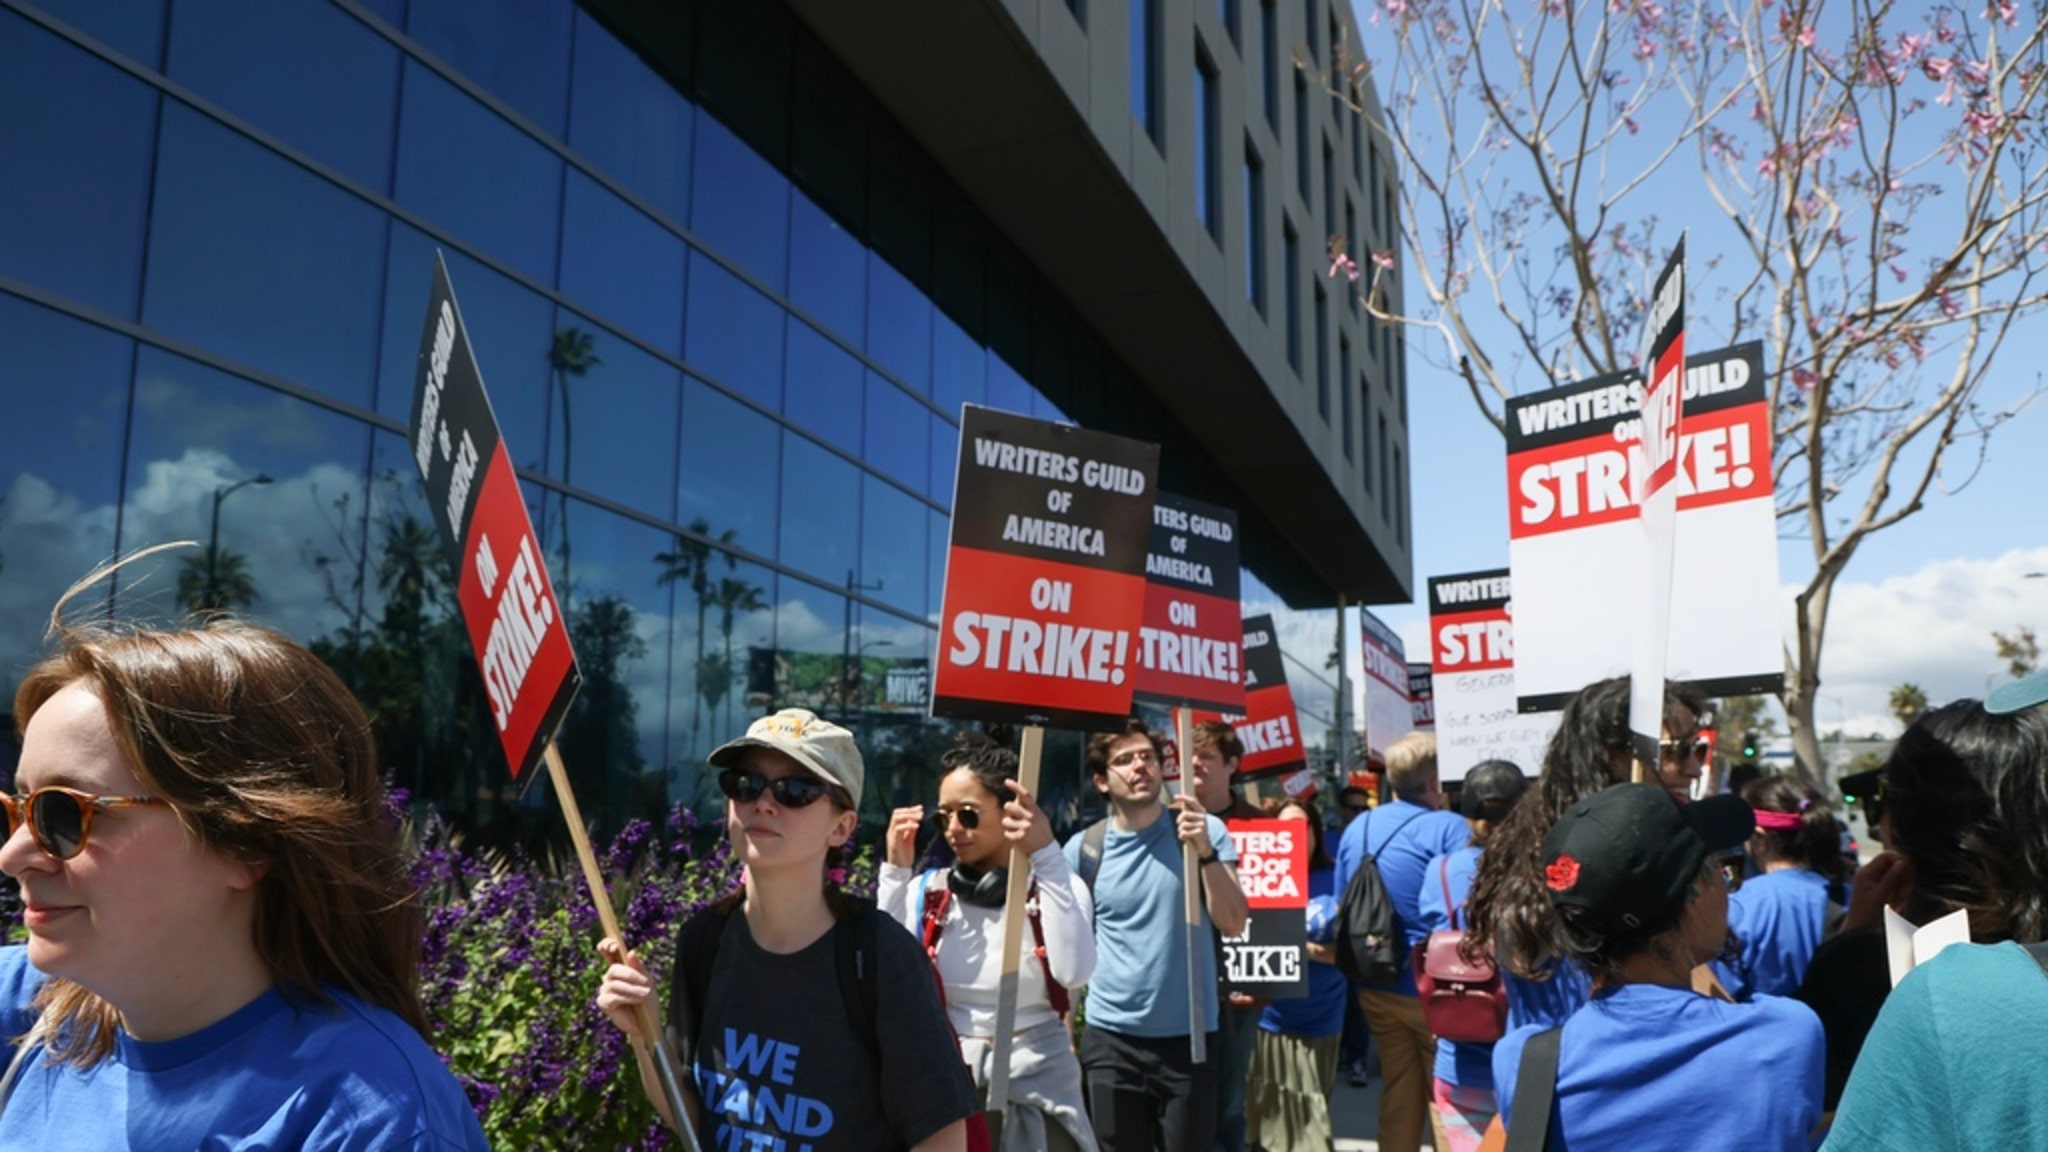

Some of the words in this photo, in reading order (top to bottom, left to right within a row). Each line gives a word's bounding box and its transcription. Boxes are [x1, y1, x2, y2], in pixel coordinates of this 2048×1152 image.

[431, 299, 456, 391] GUILD
[1517, 379, 1642, 436] WRITERS
[446, 428, 479, 543] AMERICA
[974, 437, 1080, 483] WRITERS
[1082, 459, 1146, 496] GUILD
[1047, 489, 1073, 514] OF
[1002, 514, 1105, 556] AMERICA
[1153, 504, 1189, 532] TERS
[1190, 514, 1232, 543] GUILD
[1170, 535, 1187, 554] OF
[475, 533, 498, 598] ON
[1146, 553, 1213, 586] AMERICA
[1031, 577, 1072, 613] ON
[1436, 576, 1511, 604] WRITER
[482, 534, 553, 732] STRIKE!
[1168, 600, 1196, 627] ON
[949, 610, 1129, 686] STRIKE!
[1136, 626, 1239, 684] TRIKE!
[1438, 619, 1513, 666] STR
[1235, 715, 1294, 756] IKE!
[1230, 831, 1293, 854] TERS
[1239, 875, 1300, 897] RICA
[1263, 858, 1291, 876] OF
[1221, 945, 1301, 982] RIKE
[724, 1027, 800, 1085] WE
